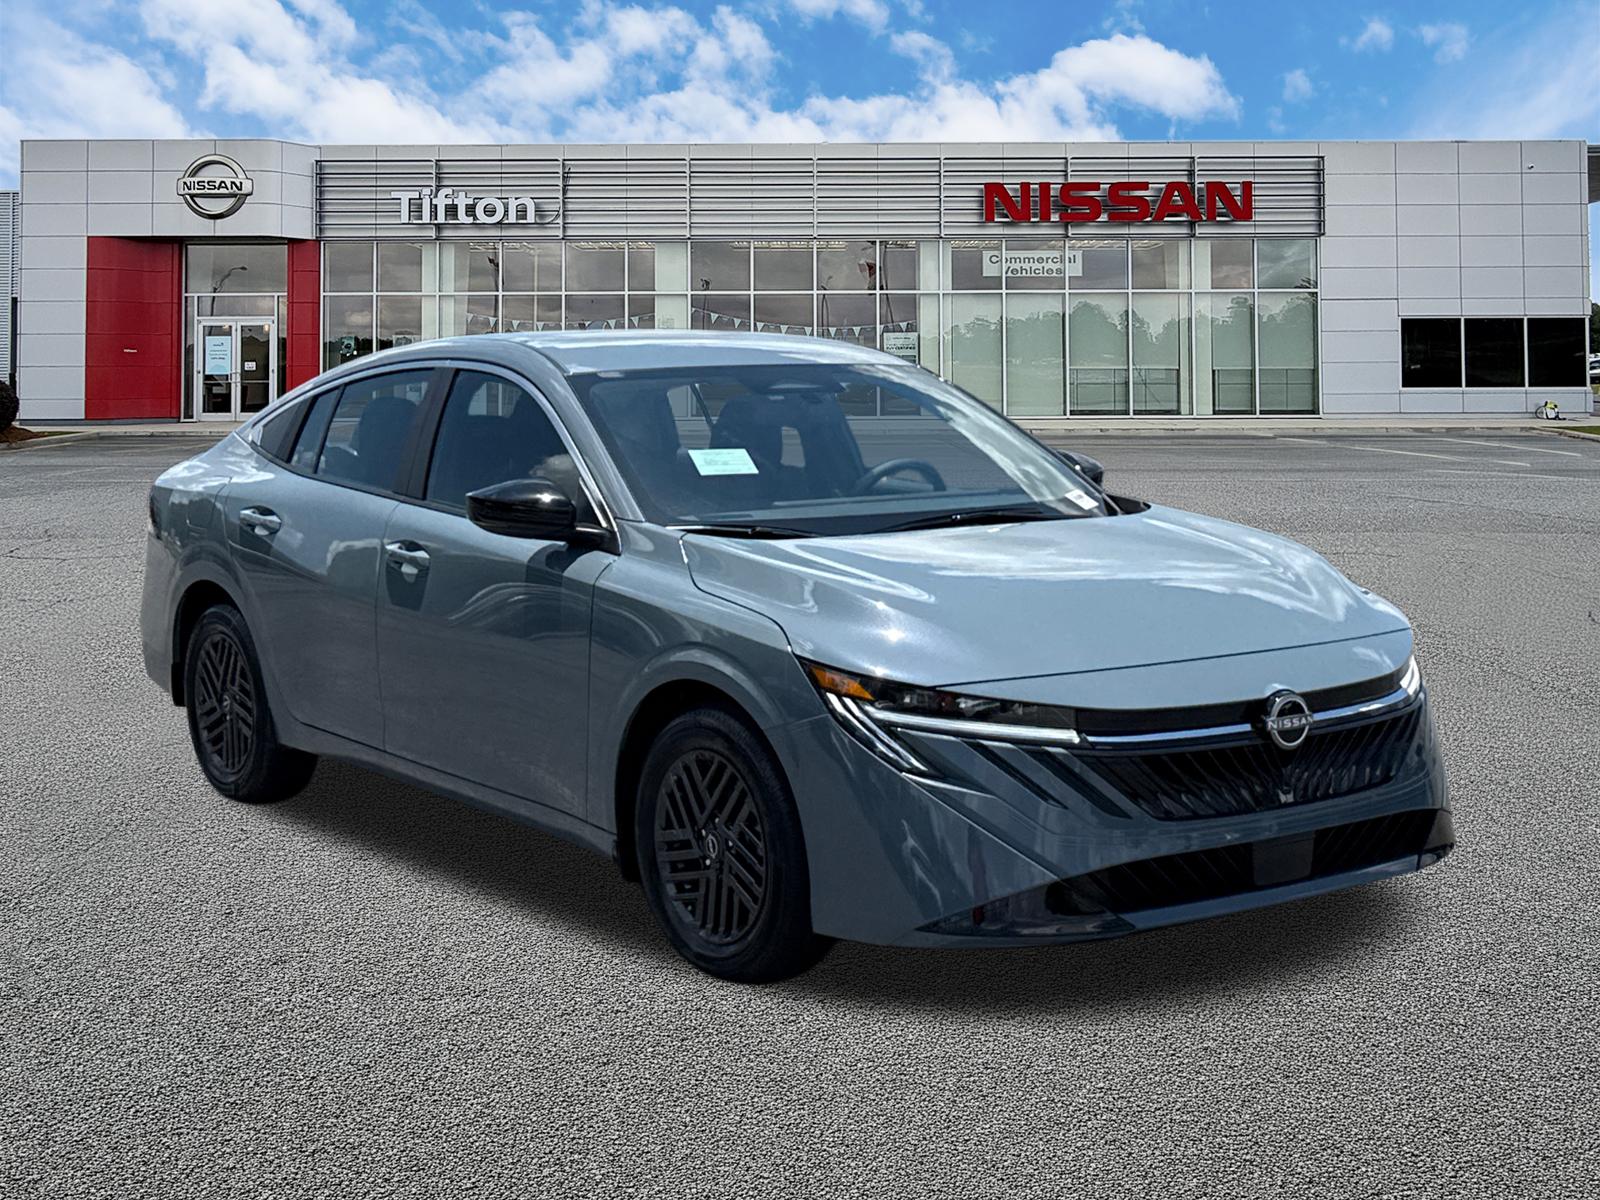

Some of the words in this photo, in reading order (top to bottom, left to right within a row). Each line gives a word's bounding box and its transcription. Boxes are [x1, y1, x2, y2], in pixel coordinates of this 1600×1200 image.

[182, 180, 243, 191] NISSAN
[391, 188, 536, 224] Tifton
[983, 181, 1253, 222] NISSAN
[1266, 715, 1313, 731] NISSAN
